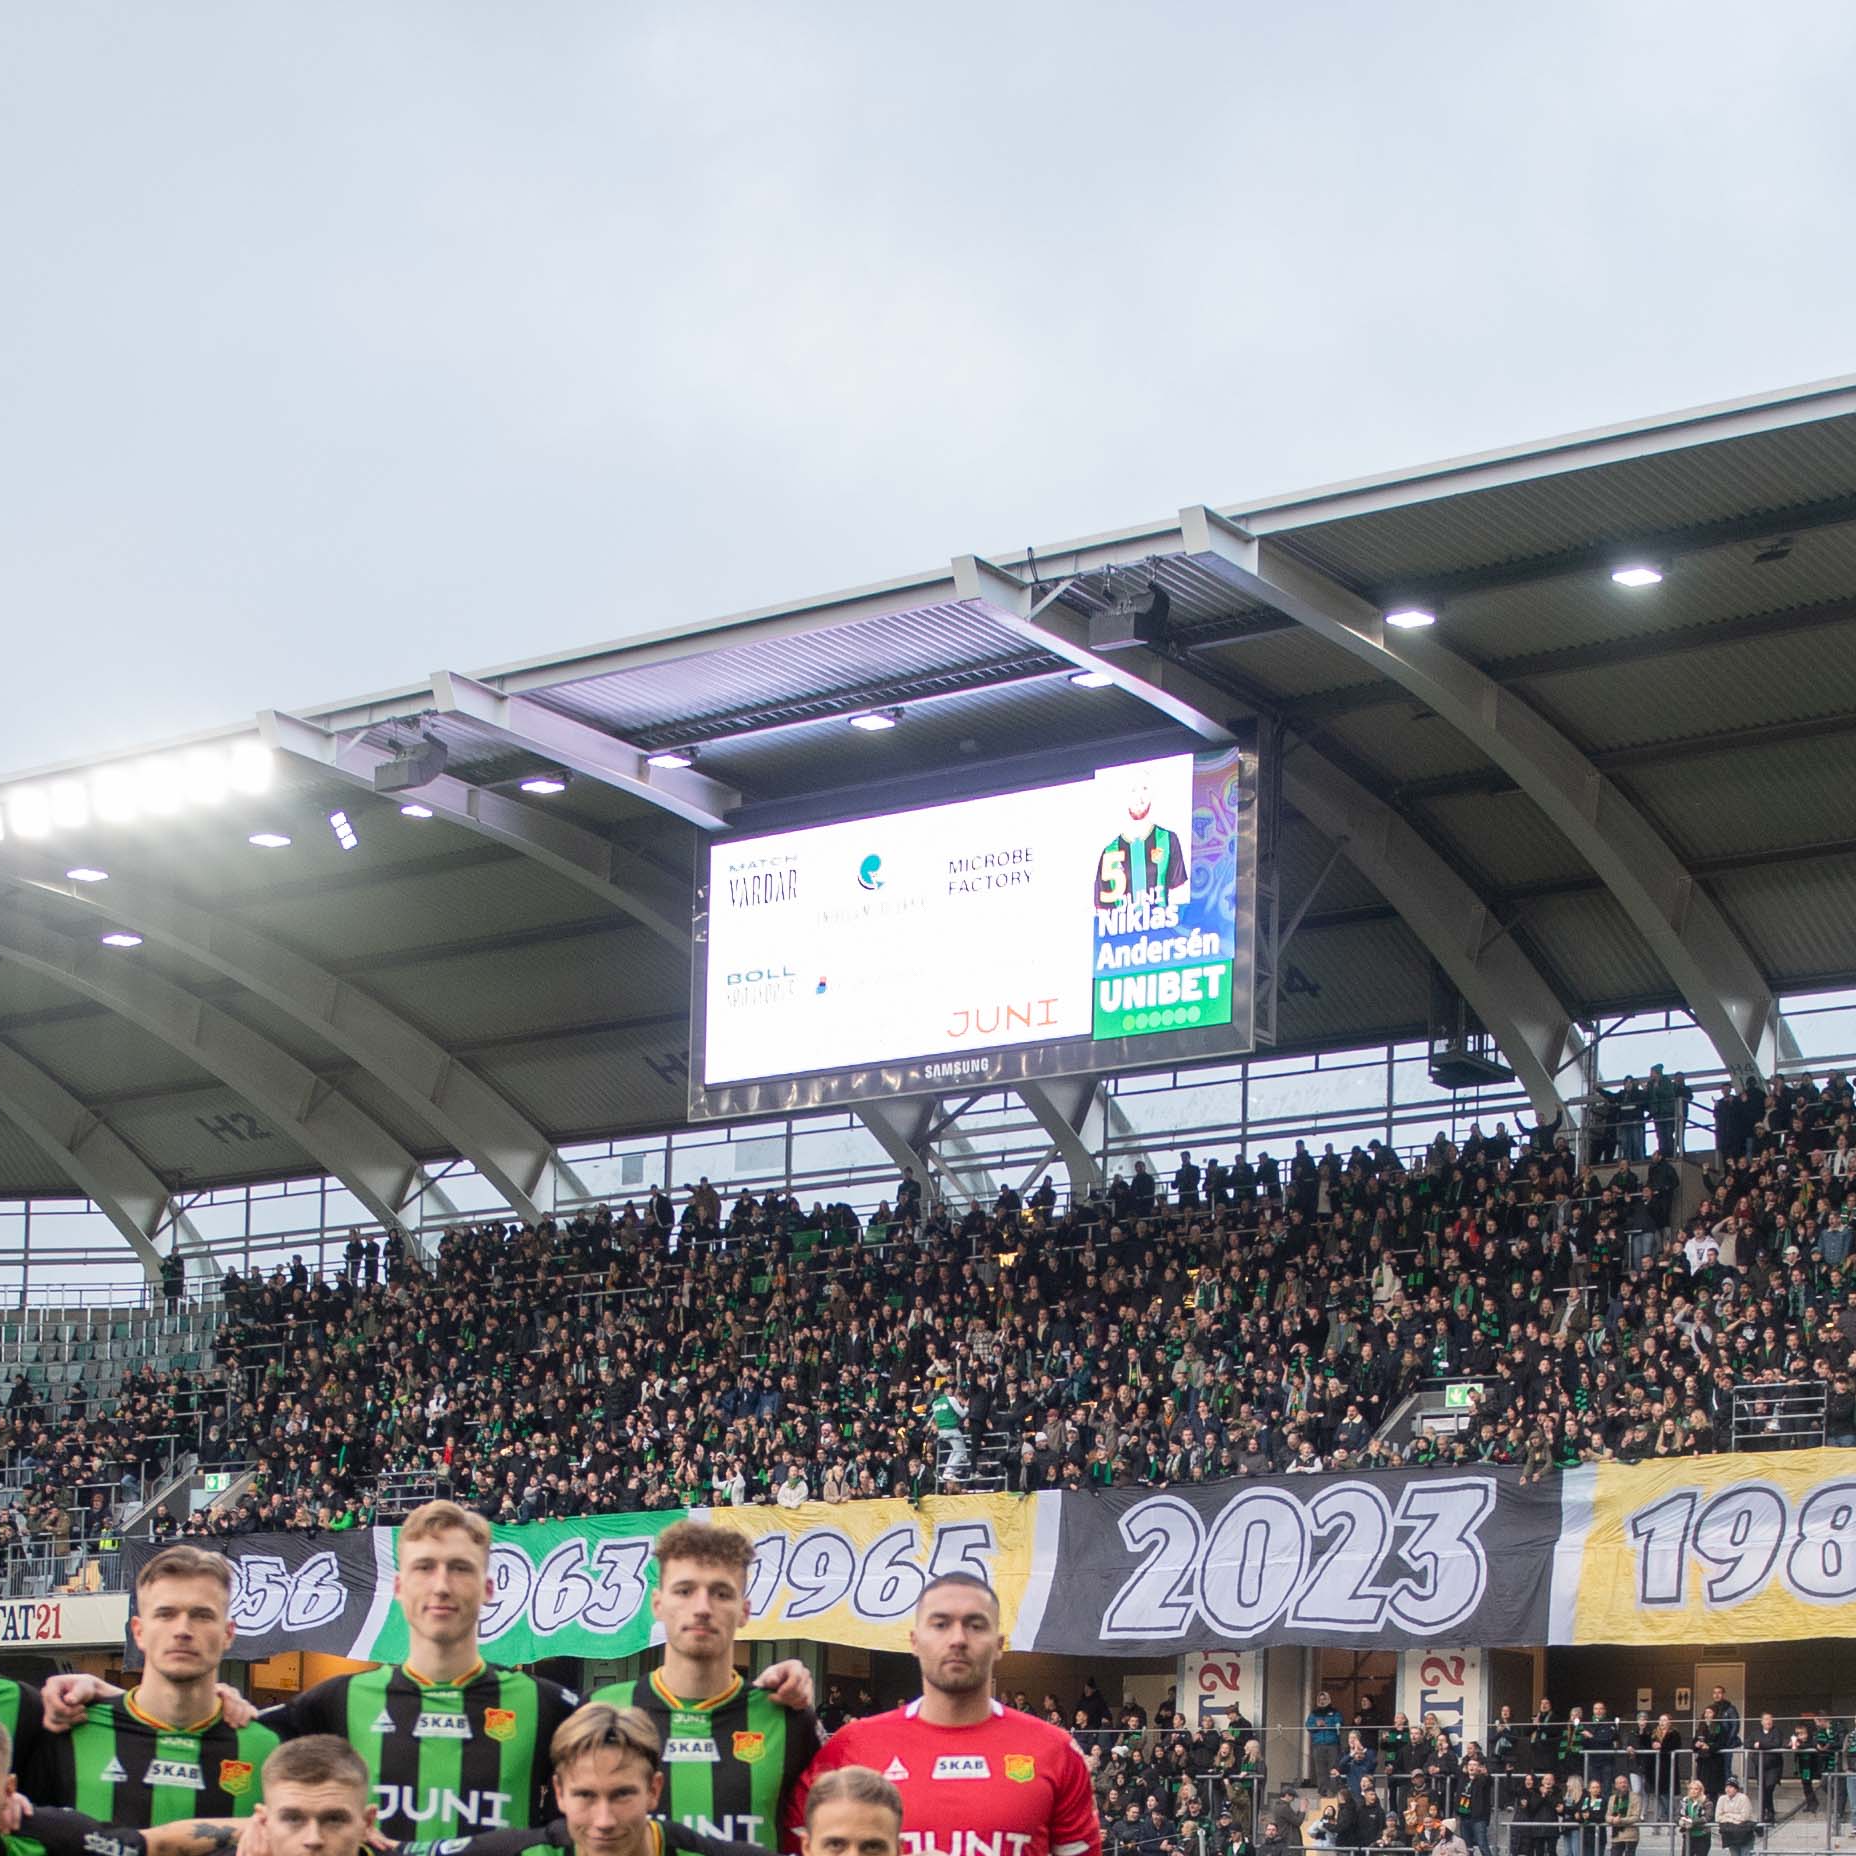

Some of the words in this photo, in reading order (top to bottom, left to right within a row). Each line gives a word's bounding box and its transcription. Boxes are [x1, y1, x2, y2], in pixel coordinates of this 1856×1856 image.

[947, 847, 1034, 875] MICROBE
[1100, 850, 1127, 903] 5
[729, 869, 797, 908] VARDAR
[947, 870, 1033, 896] FACTORY
[1096, 902, 1179, 937] Niklas
[1097, 928, 1220, 970] Andersén
[727, 965, 797, 986] BOLL
[1100, 965, 1226, 1013] UNIBET
[947, 998, 1058, 1038] JUNI
[924, 1058, 990, 1080] SAMSUNG
[194, 1111, 275, 1143] H2
[1099, 1476, 1500, 1640] 2023
[232, 1551, 349, 1638] 56
[478, 1532, 658, 1640] 963
[420, 1715, 467, 1730] SKAB
[668, 1741, 714, 1753] SKAB
[938, 1758, 985, 1771] SKAB
[151, 1762, 199, 1781] SKAB
[372, 1784, 512, 1828] JUNI
